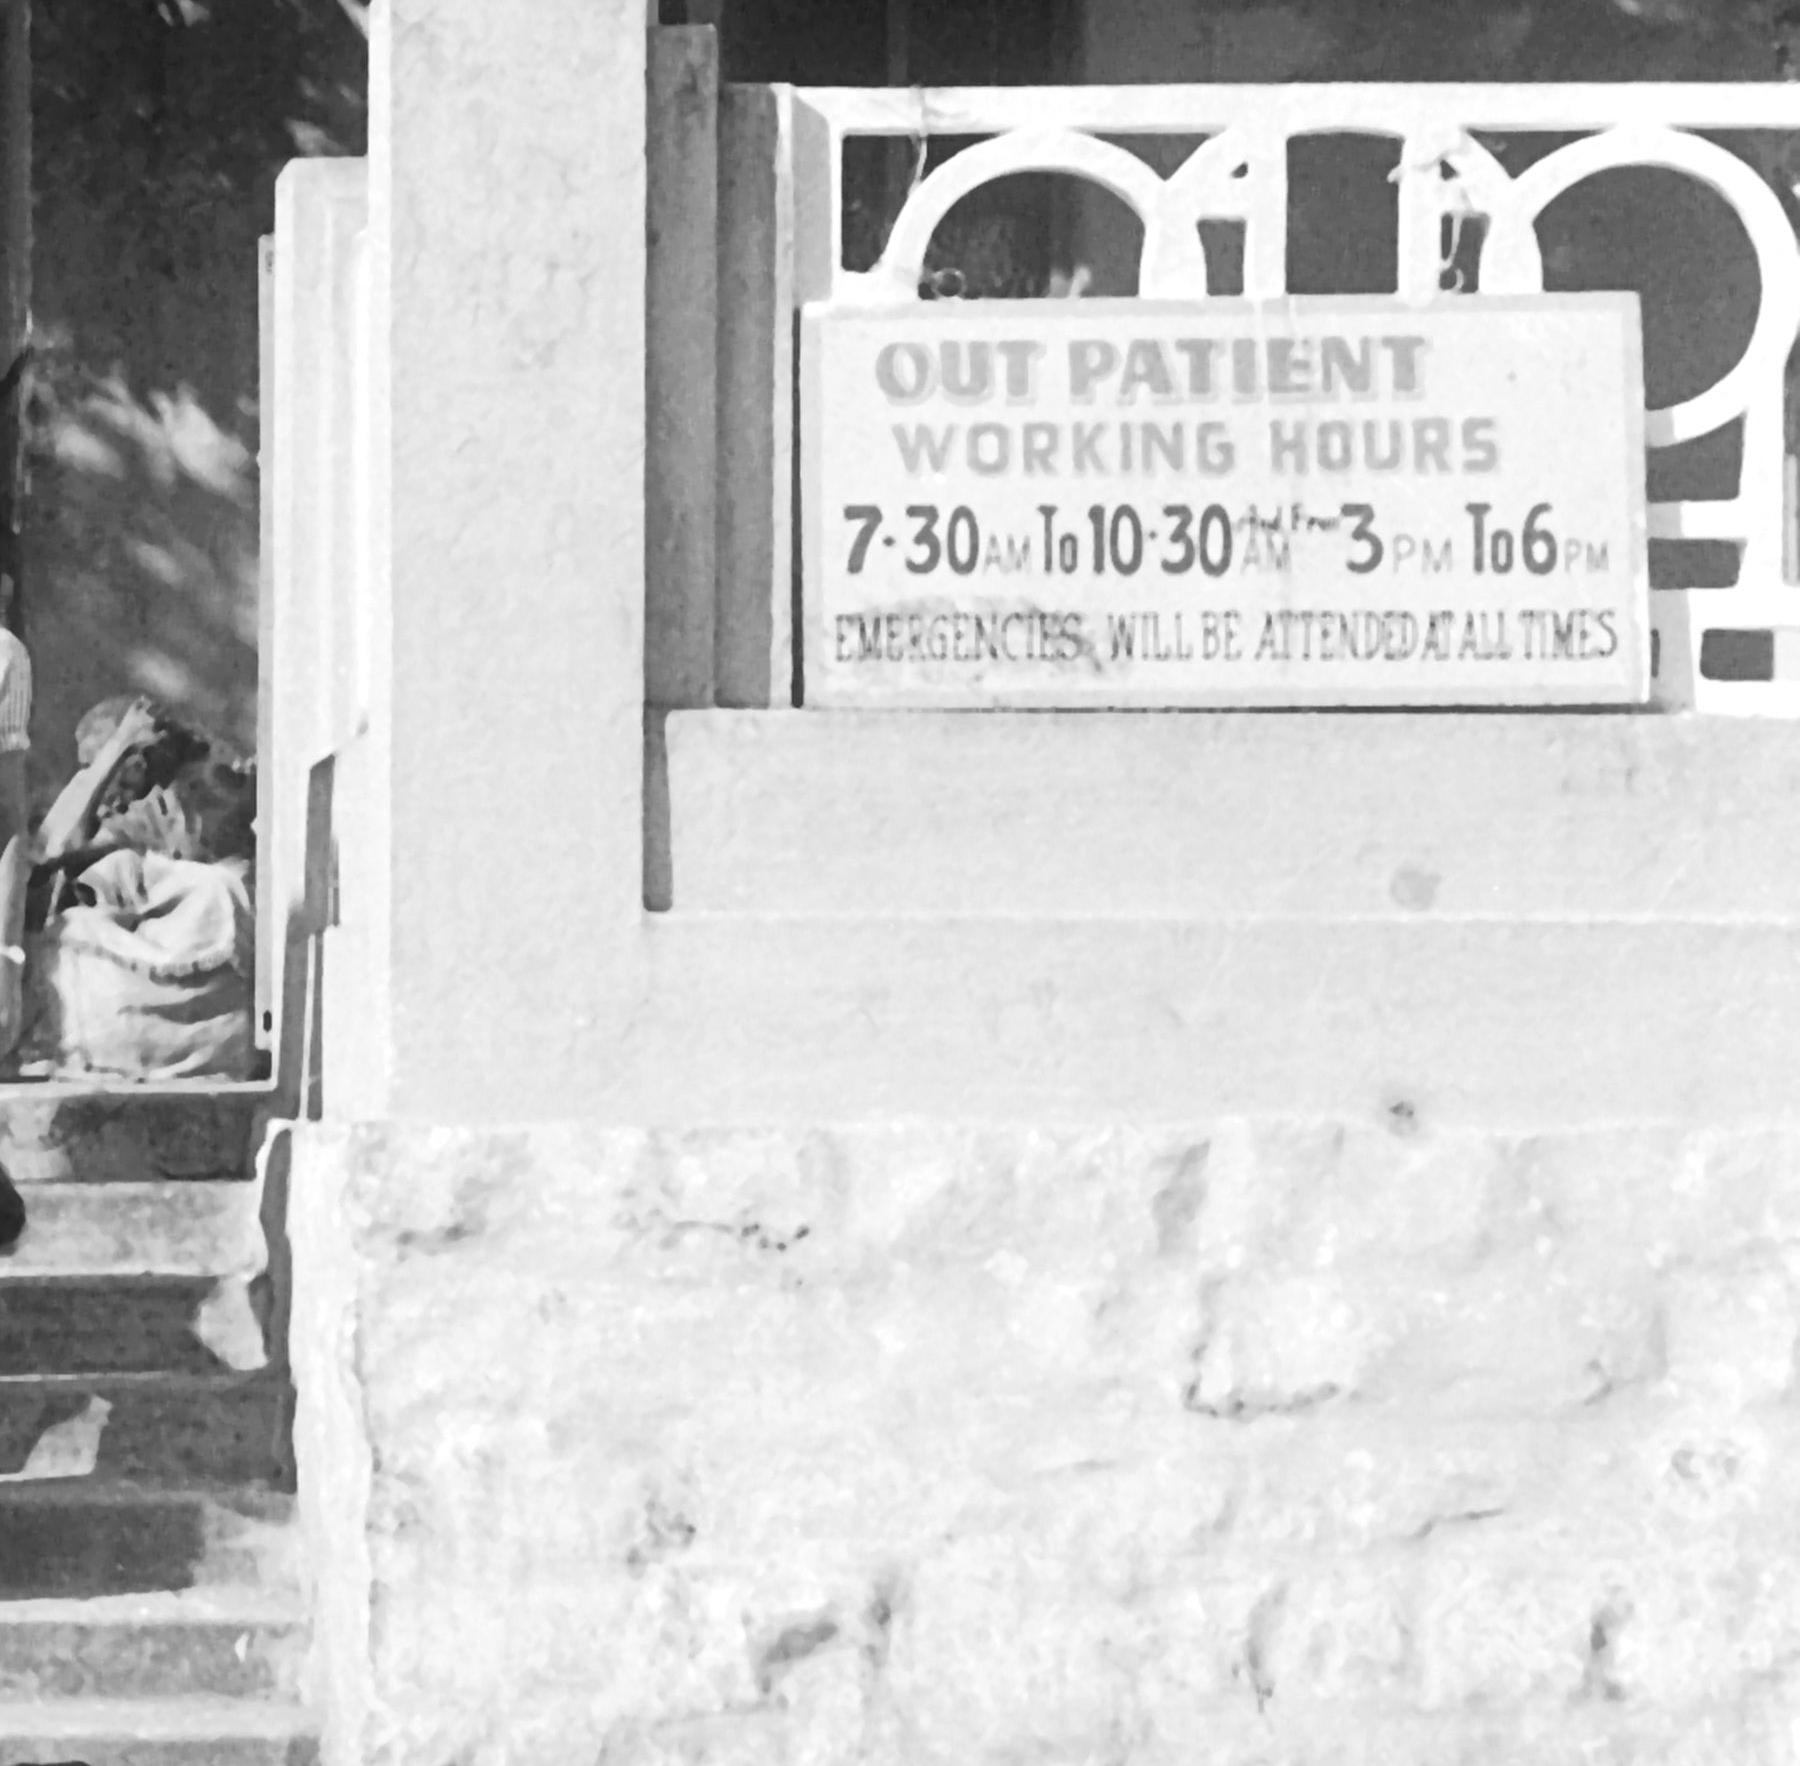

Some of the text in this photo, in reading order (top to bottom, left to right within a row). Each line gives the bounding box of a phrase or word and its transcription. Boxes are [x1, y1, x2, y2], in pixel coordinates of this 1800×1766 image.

[875, 334, 1430, 406] OUT PATIENT
[891, 417, 1503, 477] WORKING HOURS
[835, 608, 1619, 663] EMERGENCIES WILL BE ATTENDED AT ALL TIMES
